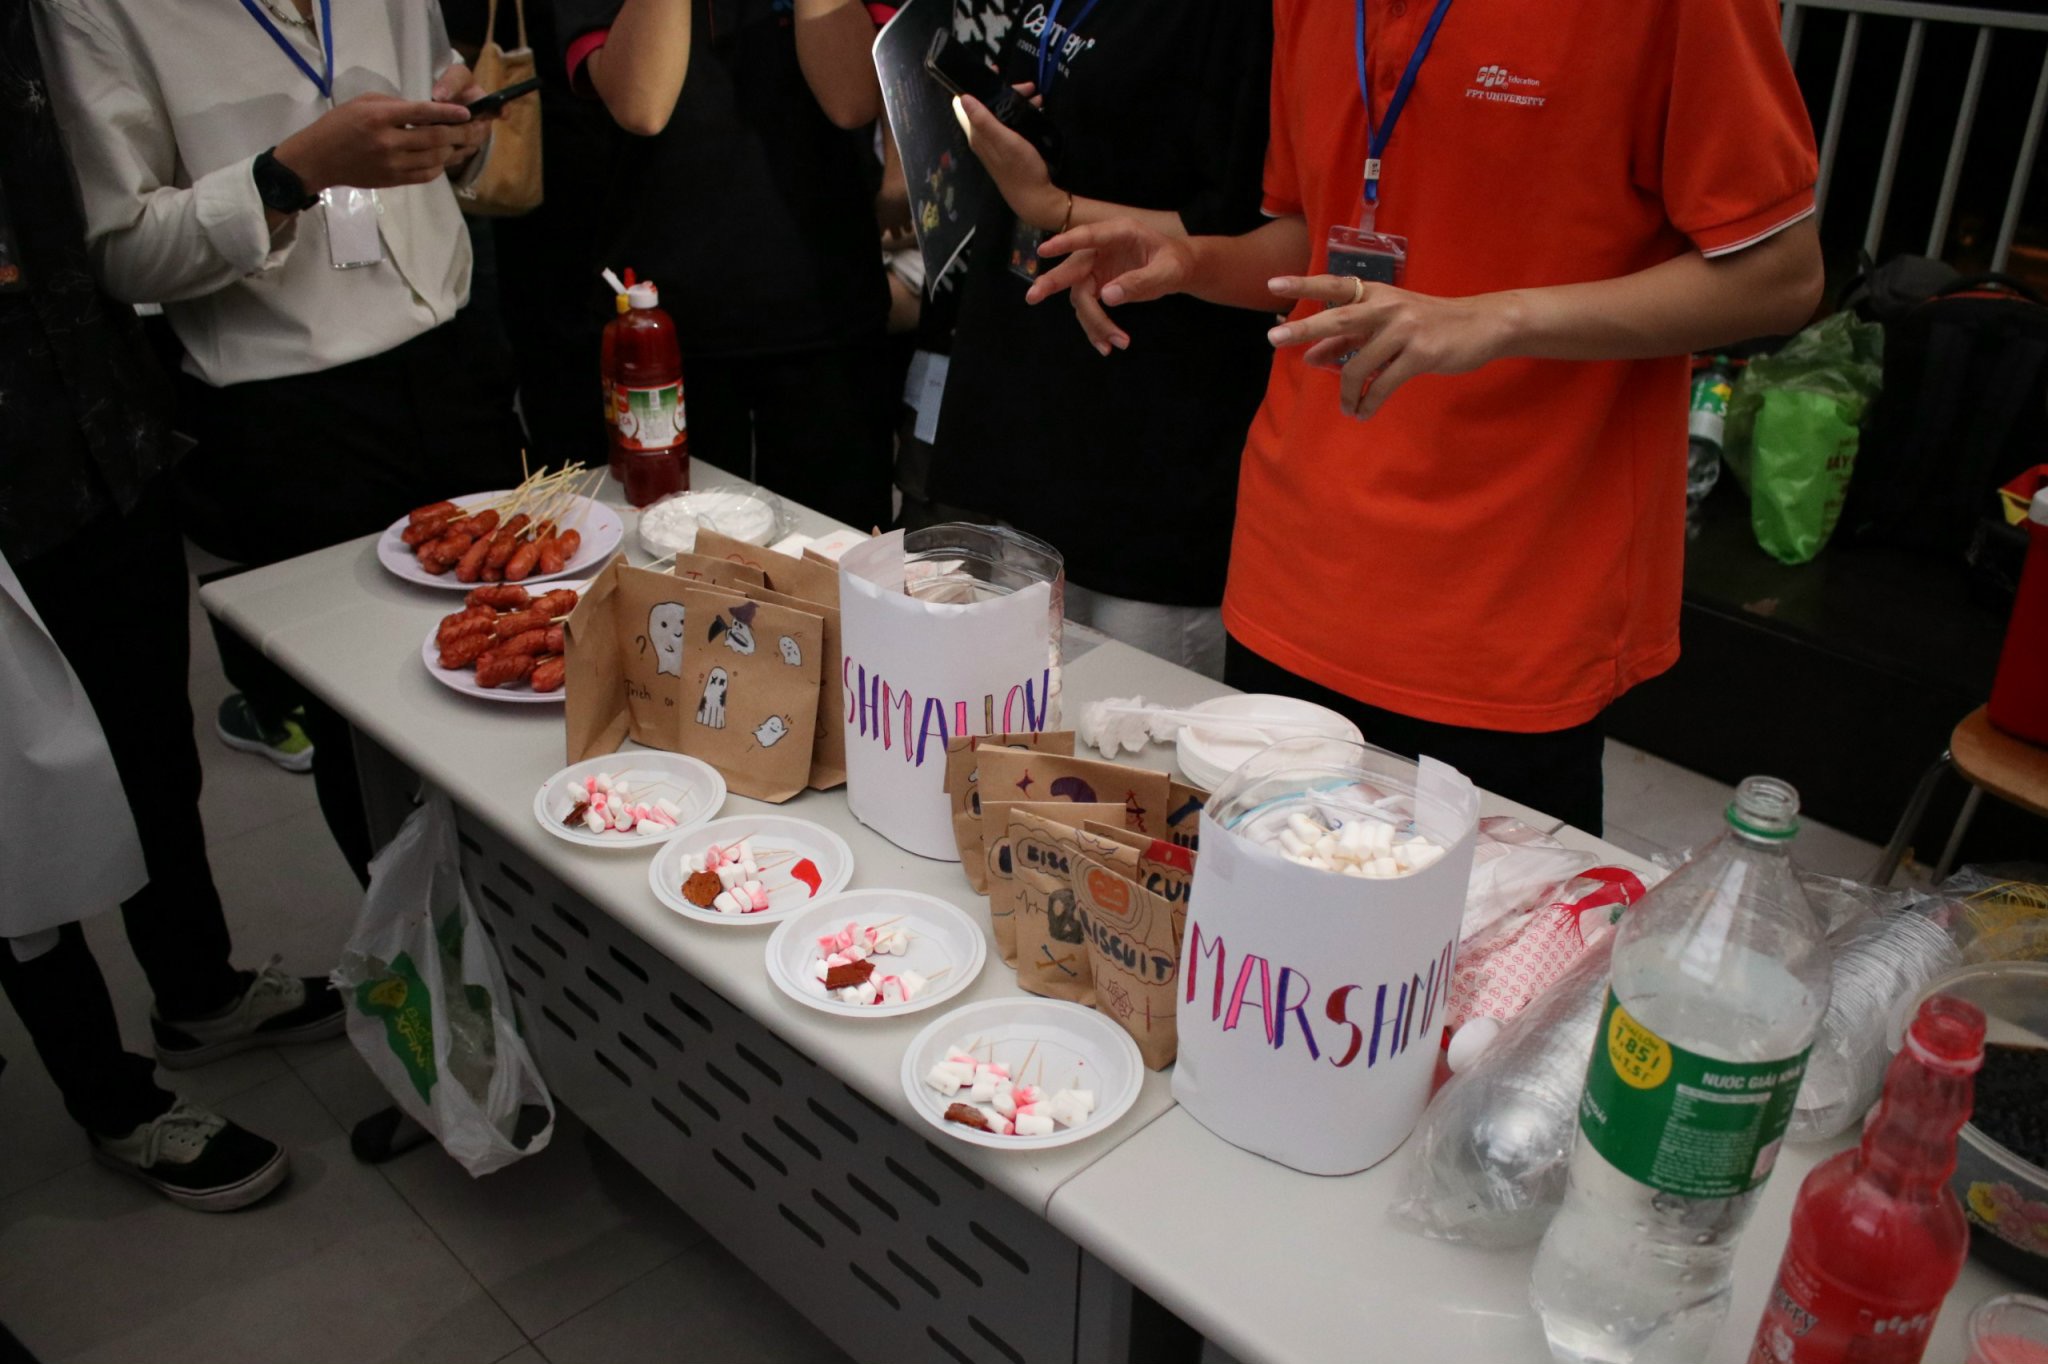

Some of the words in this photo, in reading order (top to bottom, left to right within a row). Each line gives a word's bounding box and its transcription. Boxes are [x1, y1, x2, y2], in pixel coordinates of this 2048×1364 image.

[1465, 88, 1484, 98] FPT
[1485, 91, 1546, 106] UNIVERSITY
[1186, 920, 1461, 1070] MARSHMA
[1615, 1026, 1650, 1062] 1.85
